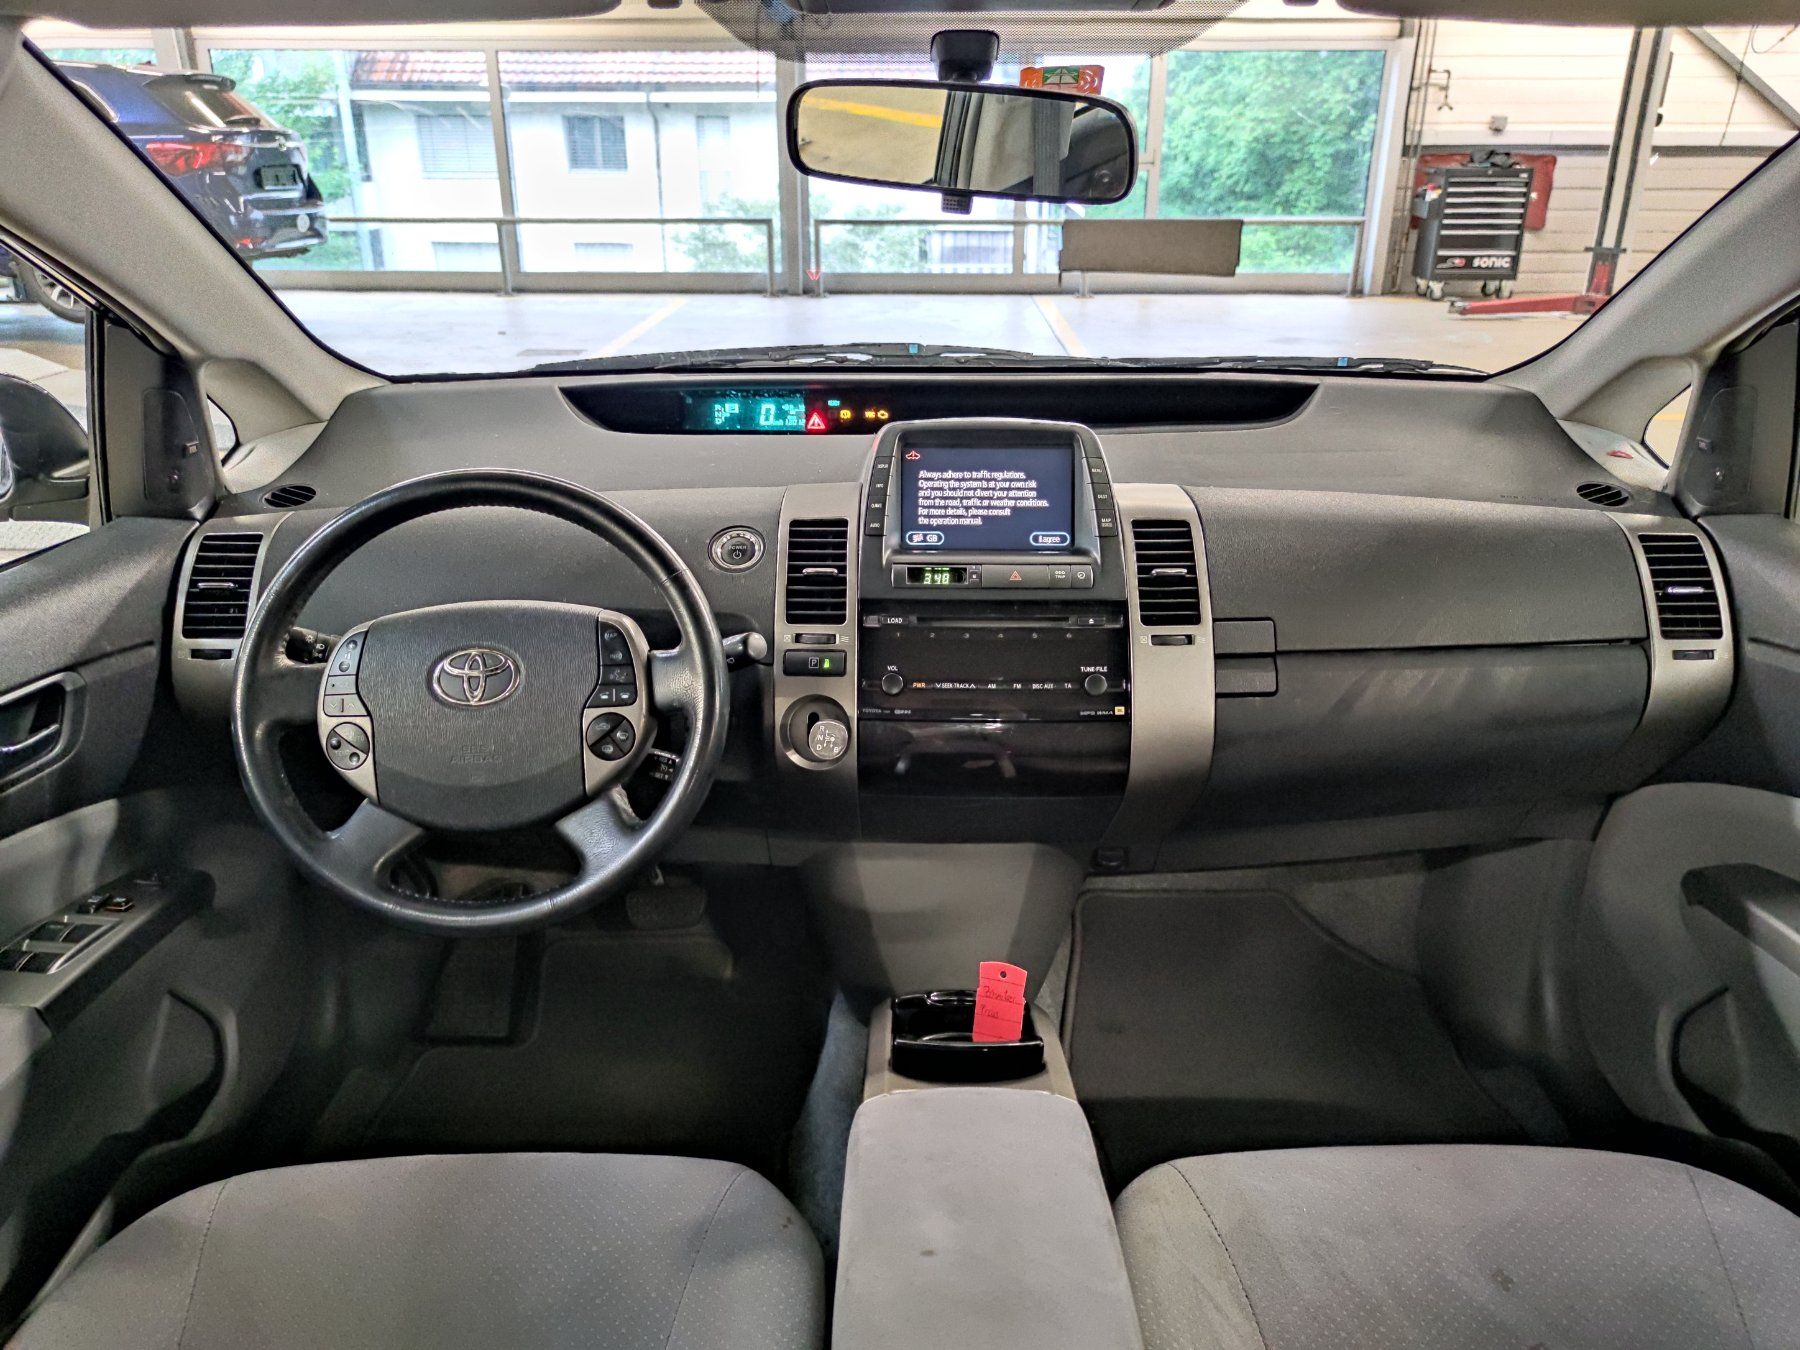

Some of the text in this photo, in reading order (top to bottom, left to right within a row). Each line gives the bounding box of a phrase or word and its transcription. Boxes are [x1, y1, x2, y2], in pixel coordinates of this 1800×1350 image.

[919, 470, 1026, 480] Always adhere to traffic regulations.
[918, 480, 949, 489] Operating
[949, 480, 960, 489] the
[960, 480, 981, 489] system
[988, 480, 996, 489] at
[996, 480, 1010, 489] your
[1010, 480, 1025, 489] own
[1025, 480, 1037, 489] risk
[918, 489, 1037, 498] and you should not divert your attention
[918, 498, 1049, 507] from the road, traffic or weather conditions.
[918, 507, 1011, 516] For more details, please consult
[918, 517, 982, 526] the operation manual.
[926, 534, 938, 542] GB
[1043, 536, 1061, 544] agree
